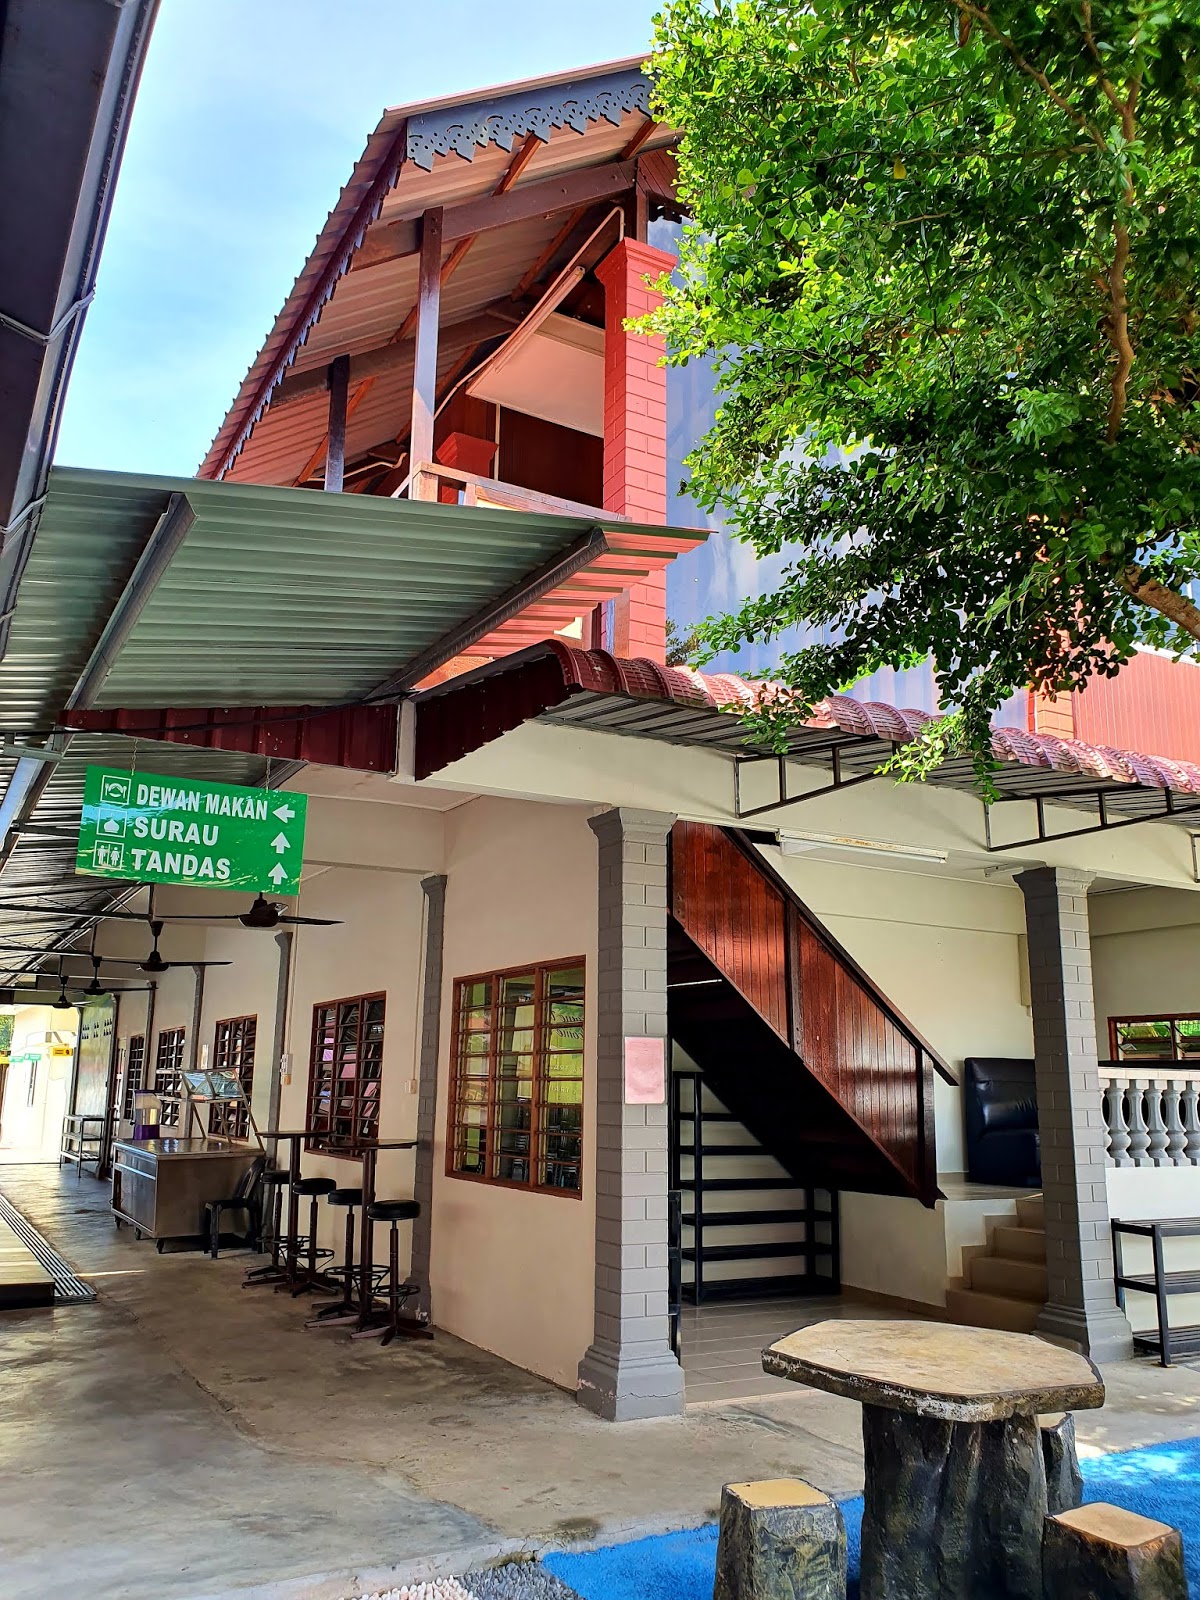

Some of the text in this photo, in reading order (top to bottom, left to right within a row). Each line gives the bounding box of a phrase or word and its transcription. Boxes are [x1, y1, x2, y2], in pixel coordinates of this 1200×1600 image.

[136, 784, 268, 821] DEWAN MAKAN
[133, 816, 219, 846] SURAU
[131, 849, 231, 880] TANDAS
